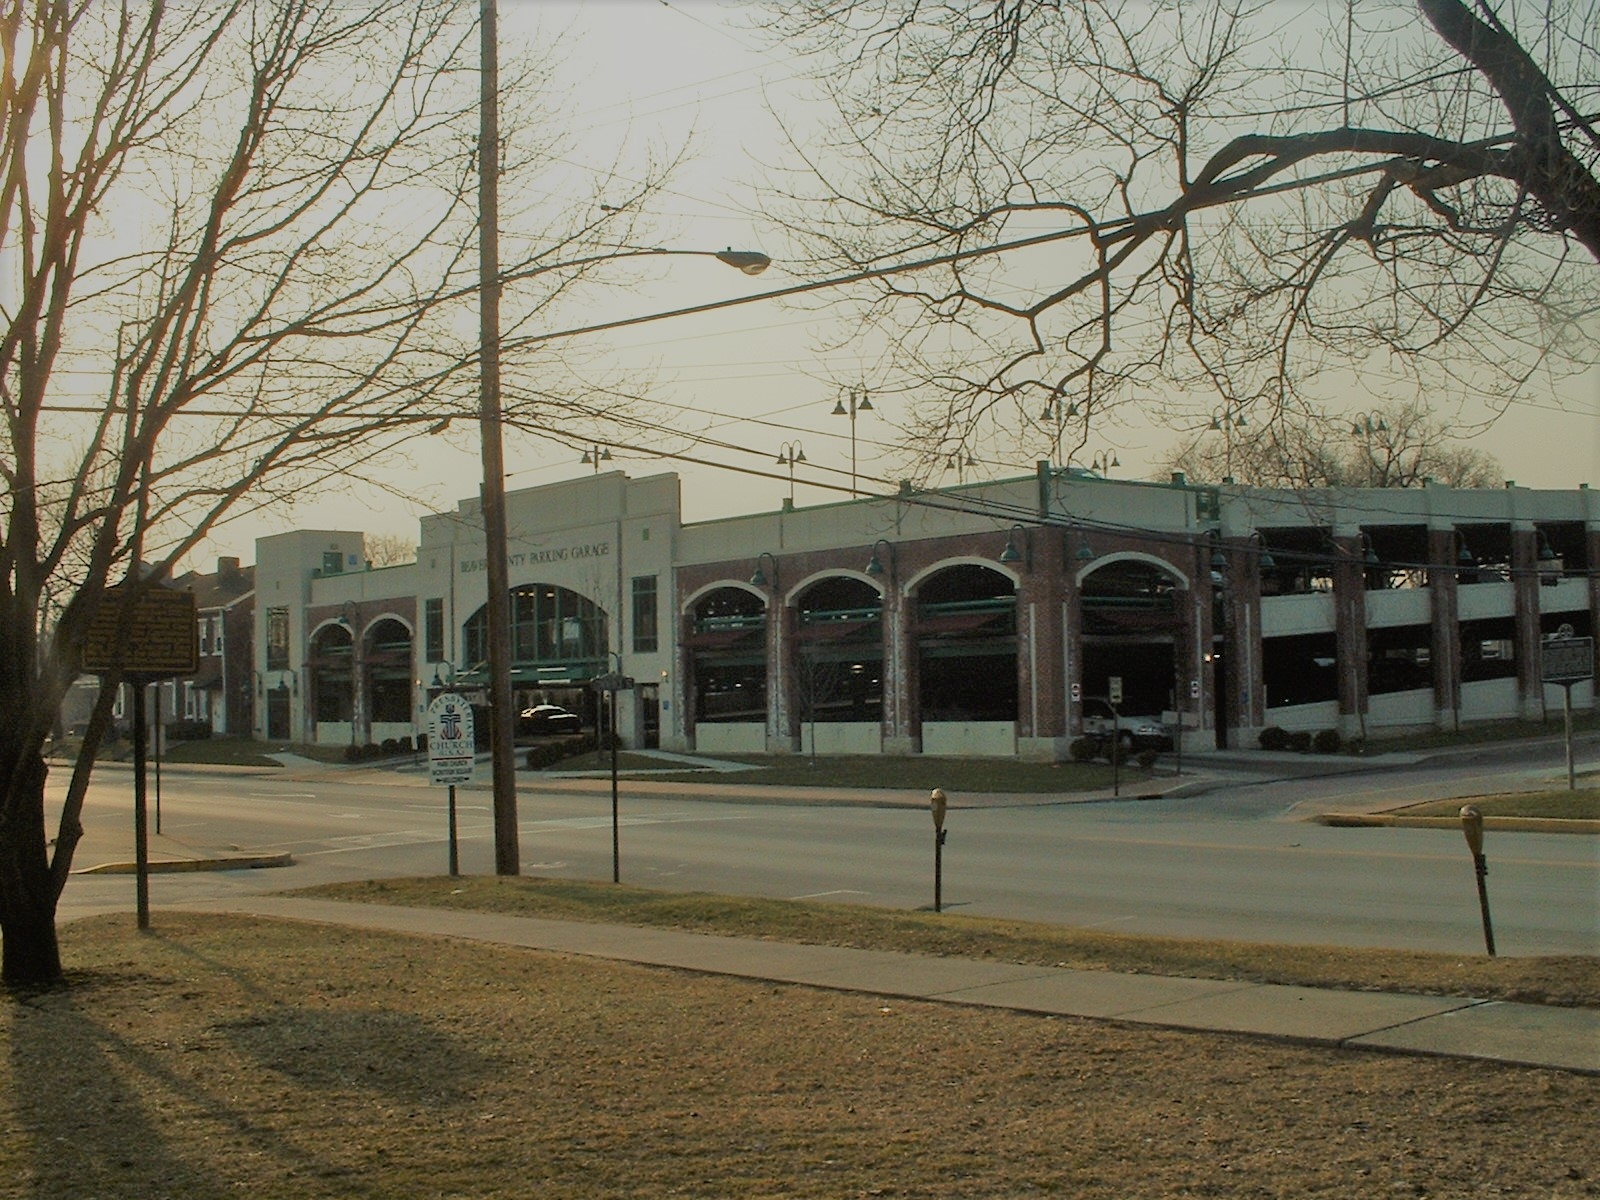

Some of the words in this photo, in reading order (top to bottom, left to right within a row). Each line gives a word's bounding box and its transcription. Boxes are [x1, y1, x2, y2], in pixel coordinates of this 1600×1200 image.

[530, 547, 568, 564] PARKING
[571, 542, 609, 559] GARAGE
[429, 740, 473, 751] CHURCH
